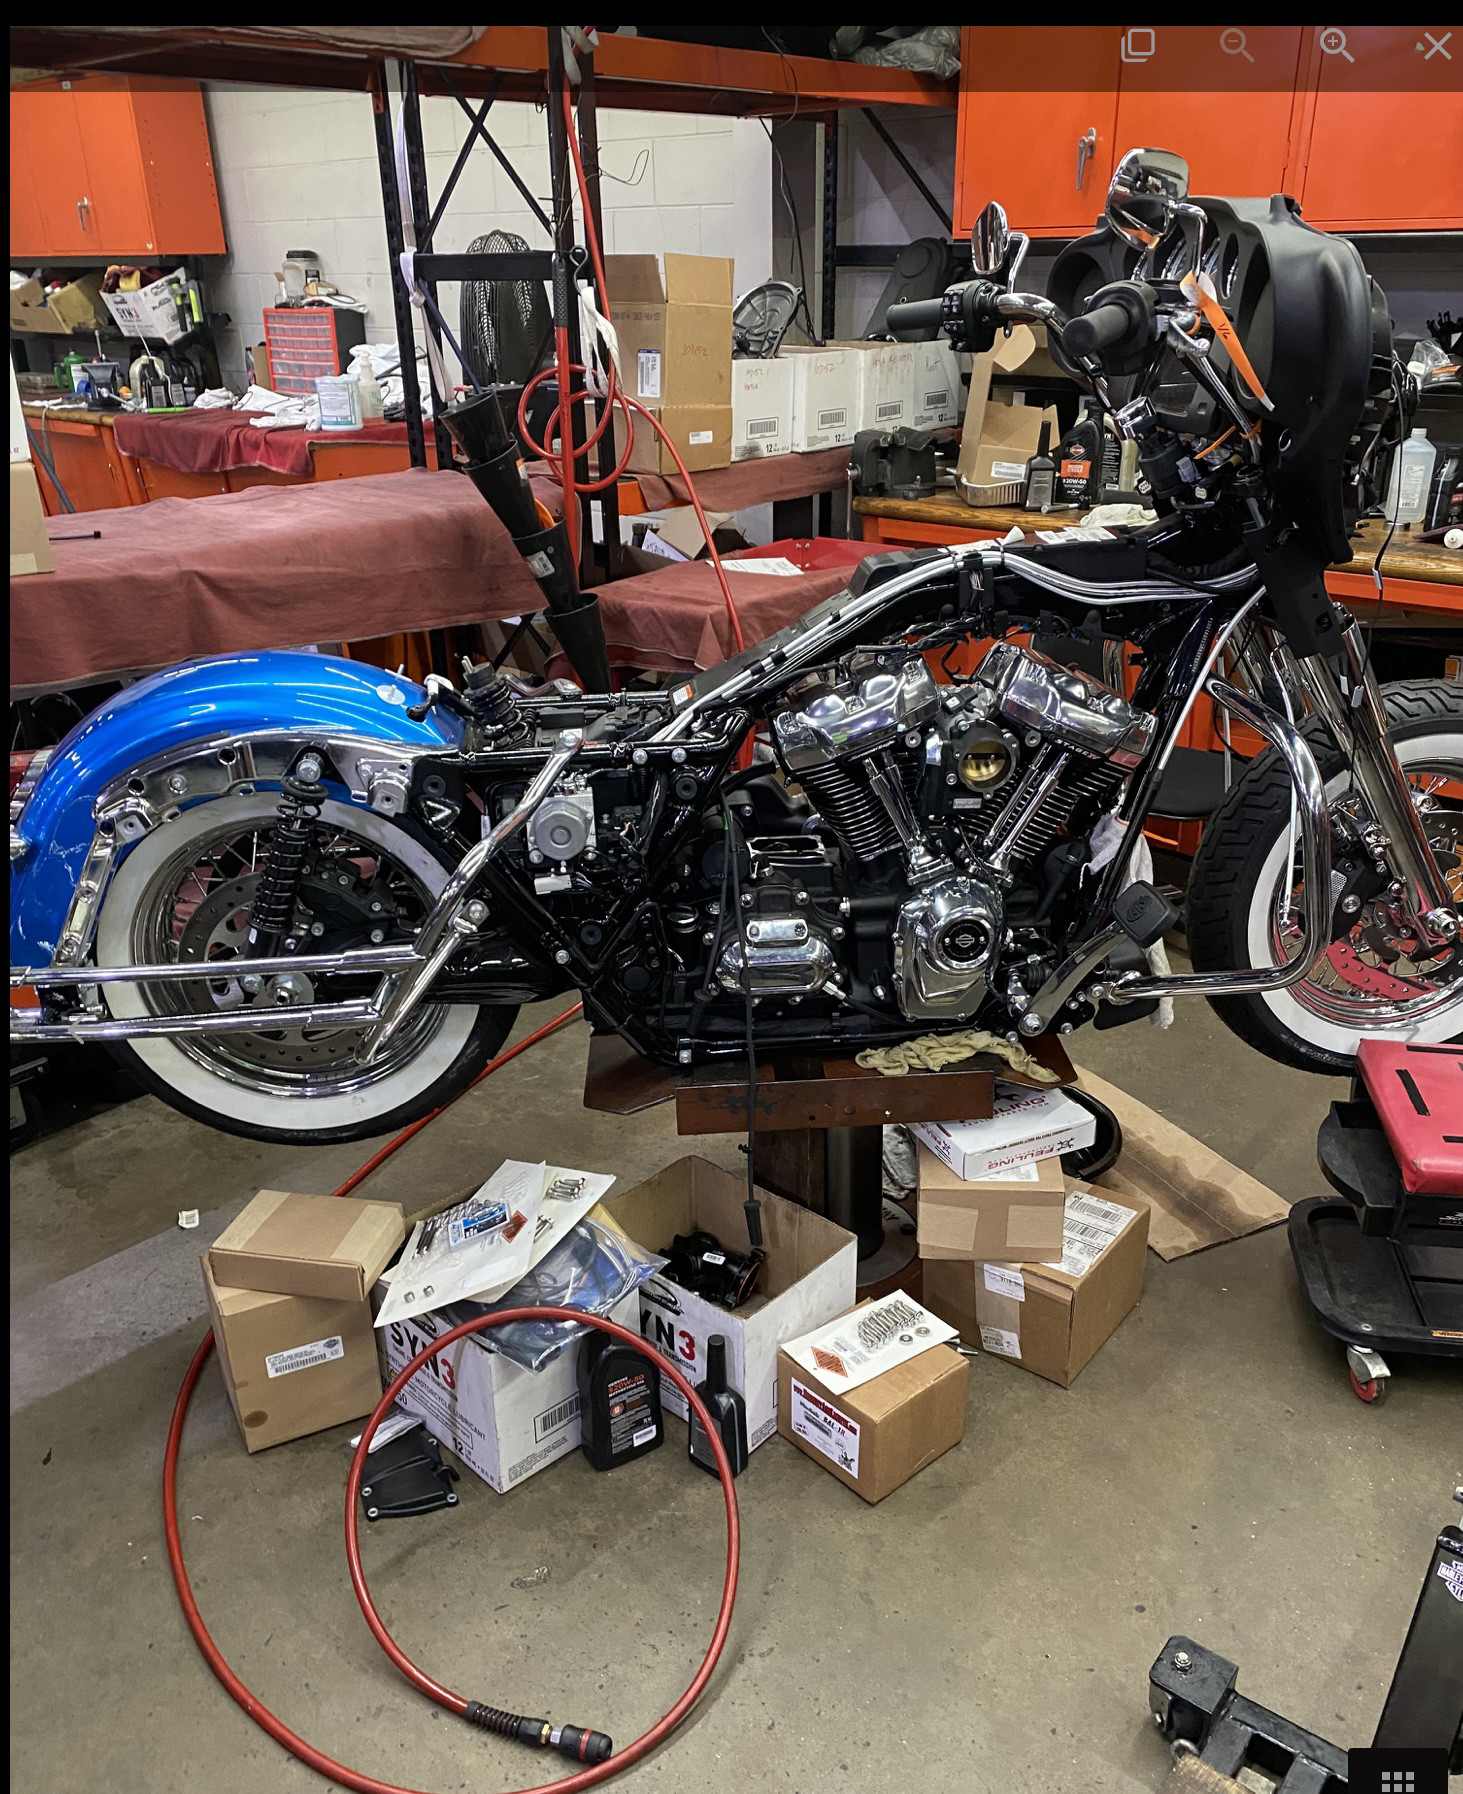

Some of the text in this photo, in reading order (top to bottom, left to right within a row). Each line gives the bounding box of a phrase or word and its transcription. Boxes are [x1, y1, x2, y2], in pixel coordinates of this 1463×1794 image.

[766, 444, 773, 453] 12
[835, 434, 844, 442] 12
[988, 1147, 1055, 1170] FEULING
[640, 1309, 696, 1361] YN3
[452, 1408, 486, 1441] LUBRICANT
[452, 1436, 465, 1456] 12
